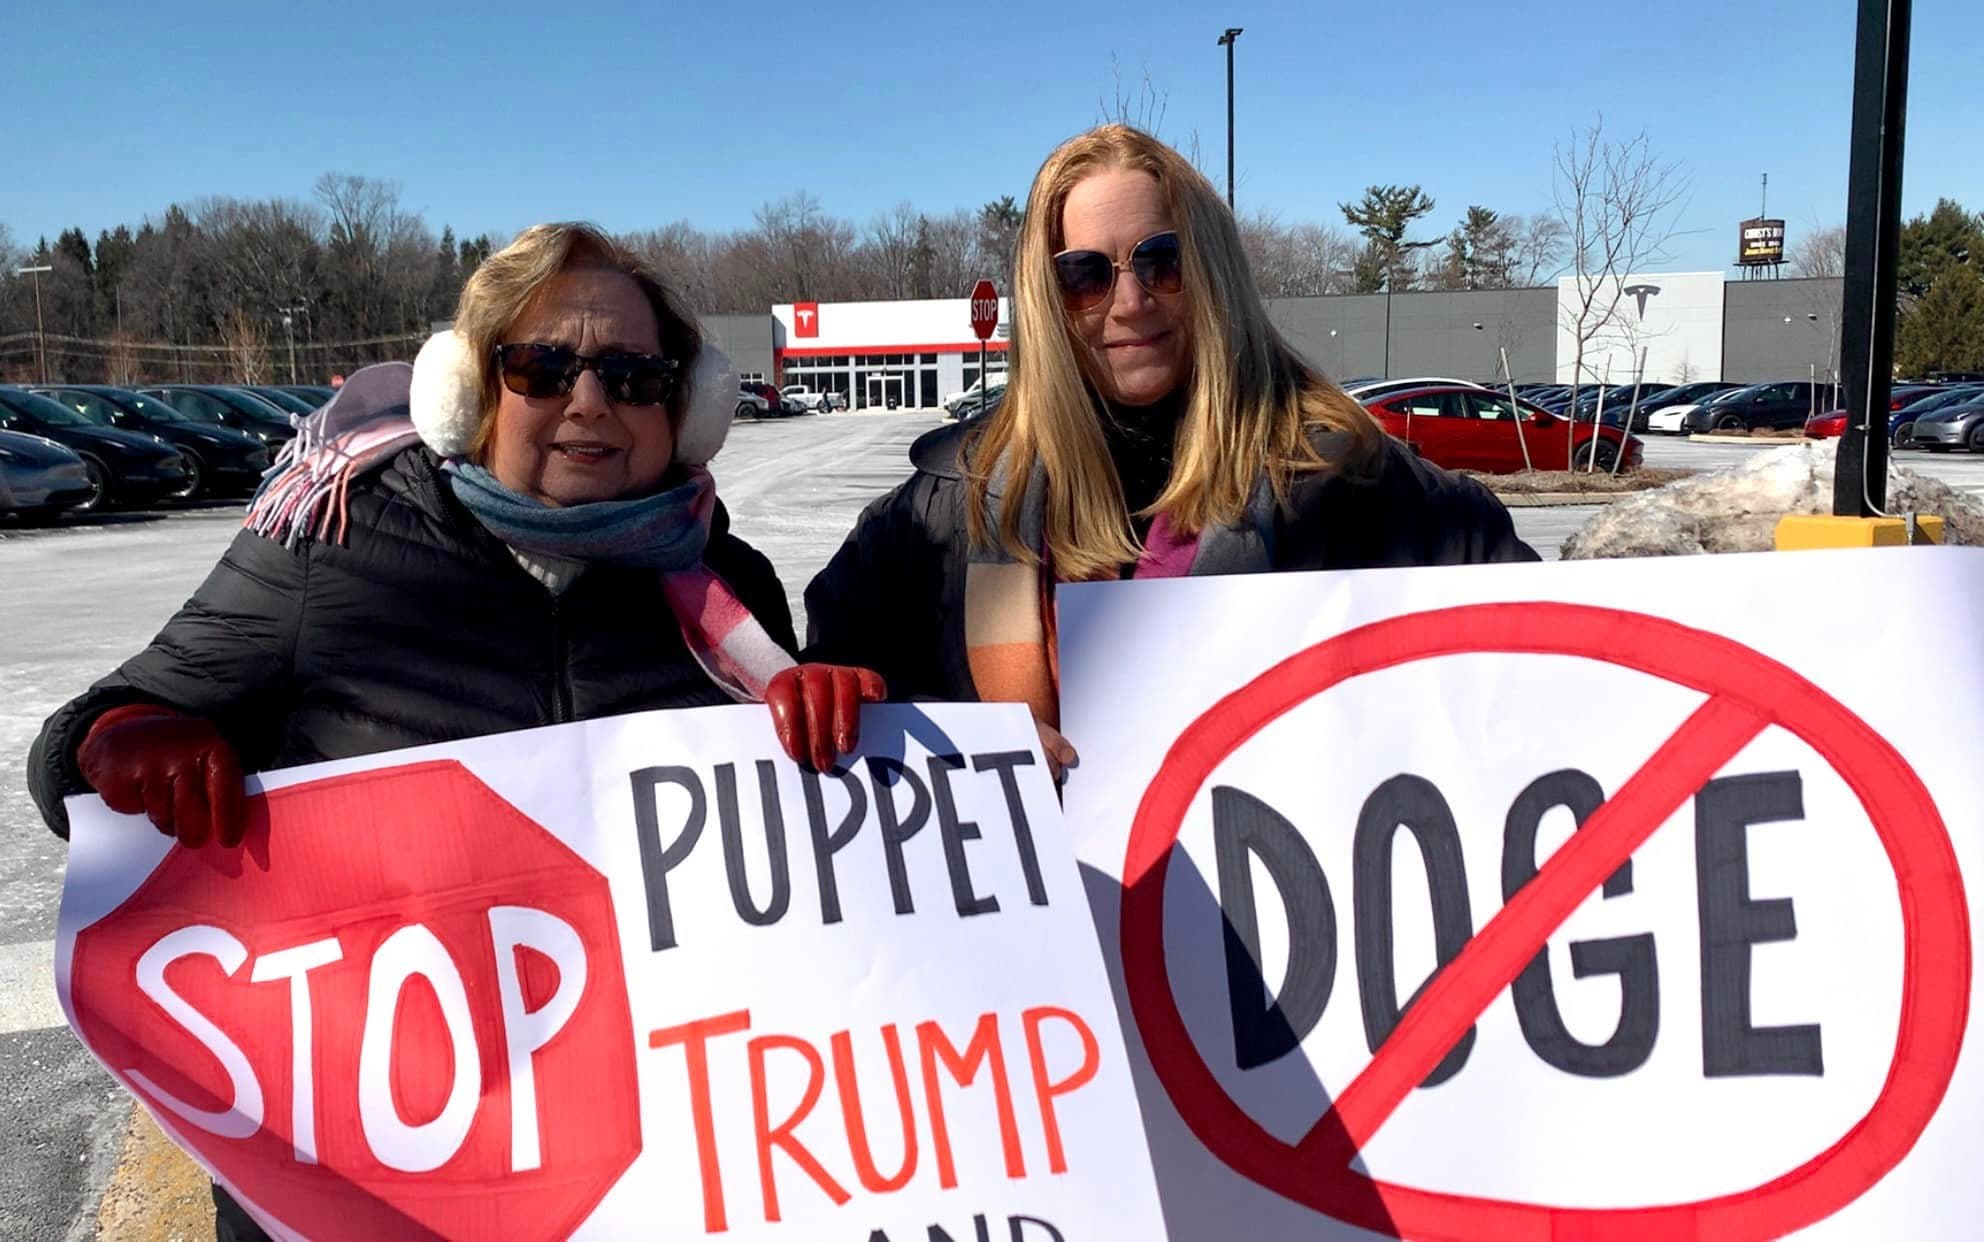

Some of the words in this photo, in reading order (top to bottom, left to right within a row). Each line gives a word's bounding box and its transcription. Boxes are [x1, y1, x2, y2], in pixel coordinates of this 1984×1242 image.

[973, 298, 997, 321] STOP
[630, 750, 1049, 952] PUPPET
[1211, 768, 1824, 1089] DOGE
[124, 905, 588, 1173] STOP
[649, 1006, 1100, 1234] TRUMP
